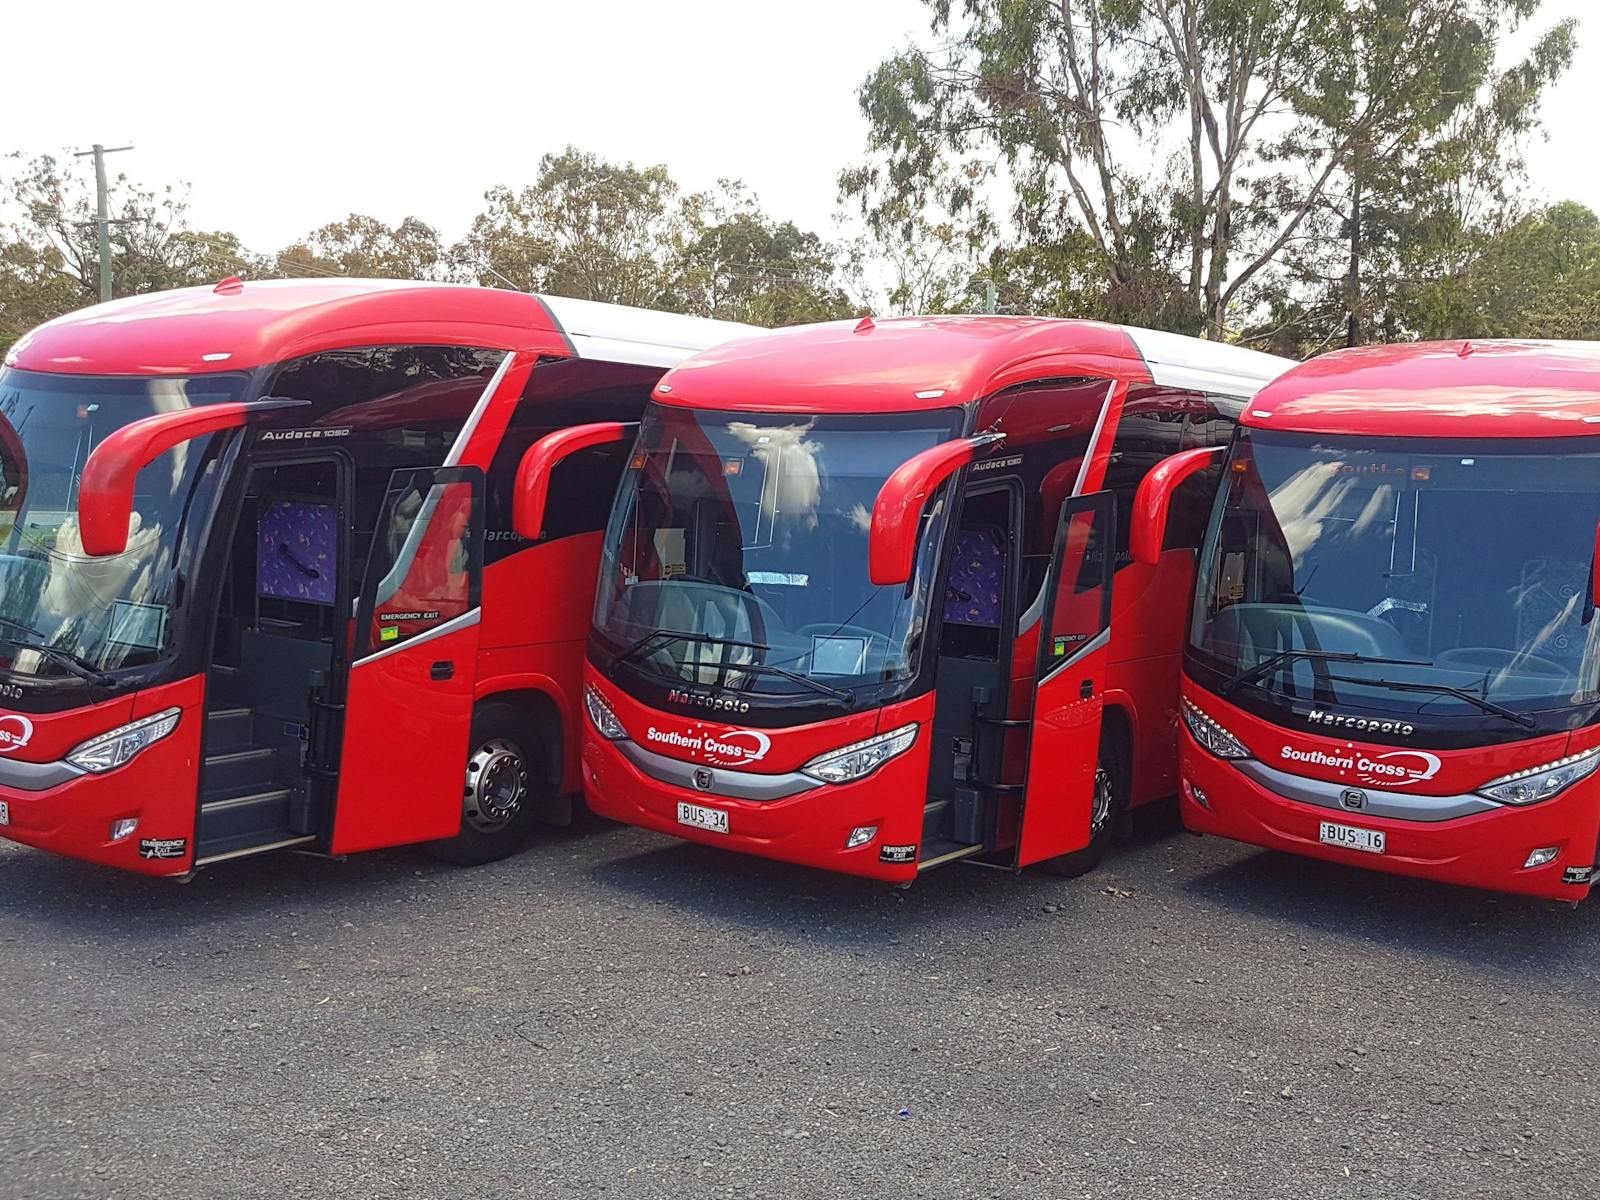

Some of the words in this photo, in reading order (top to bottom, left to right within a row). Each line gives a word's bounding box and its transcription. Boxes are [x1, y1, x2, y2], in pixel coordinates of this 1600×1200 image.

[261, 430, 321, 440] Audace
[323, 429, 350, 437] 1050
[972, 461, 1006, 471] Audace
[667, 689, 750, 713] Marcopolo
[1307, 710, 1414, 735] Marcopolo
[647, 726, 702, 749] Southern
[704, 738, 743, 756] Cross
[1281, 745, 1353, 768] Southern
[1357, 757, 1405, 776] Cross
[683, 805, 705, 823] BUS
[713, 812, 726, 828] 34
[1328, 825, 1356, 843] BUS
[1368, 832, 1382, 848] 16
[883, 845, 916, 853] EMERGENCY
